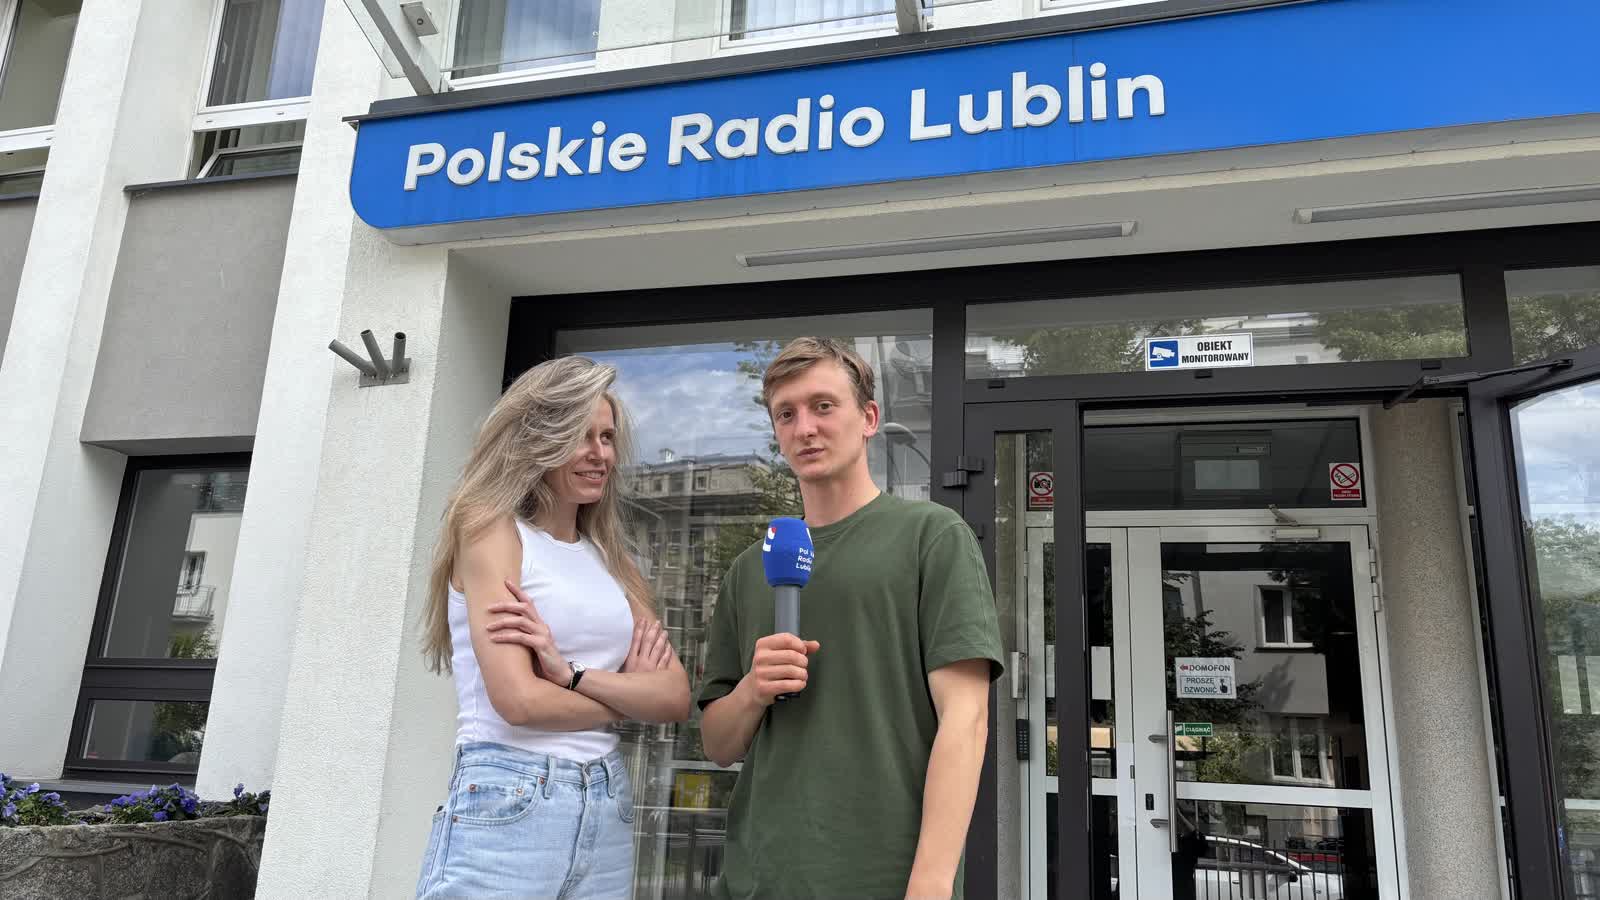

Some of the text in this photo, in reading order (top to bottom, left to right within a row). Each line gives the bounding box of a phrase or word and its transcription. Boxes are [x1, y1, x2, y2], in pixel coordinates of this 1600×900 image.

[403, 62, 1166, 191] Polskie Radio Lublin
[1197, 340, 1232, 351] OBIEKT
[1181, 353, 1249, 363] MONITOROWANY
[1184, 685, 1217, 693] DZWONIĆ
